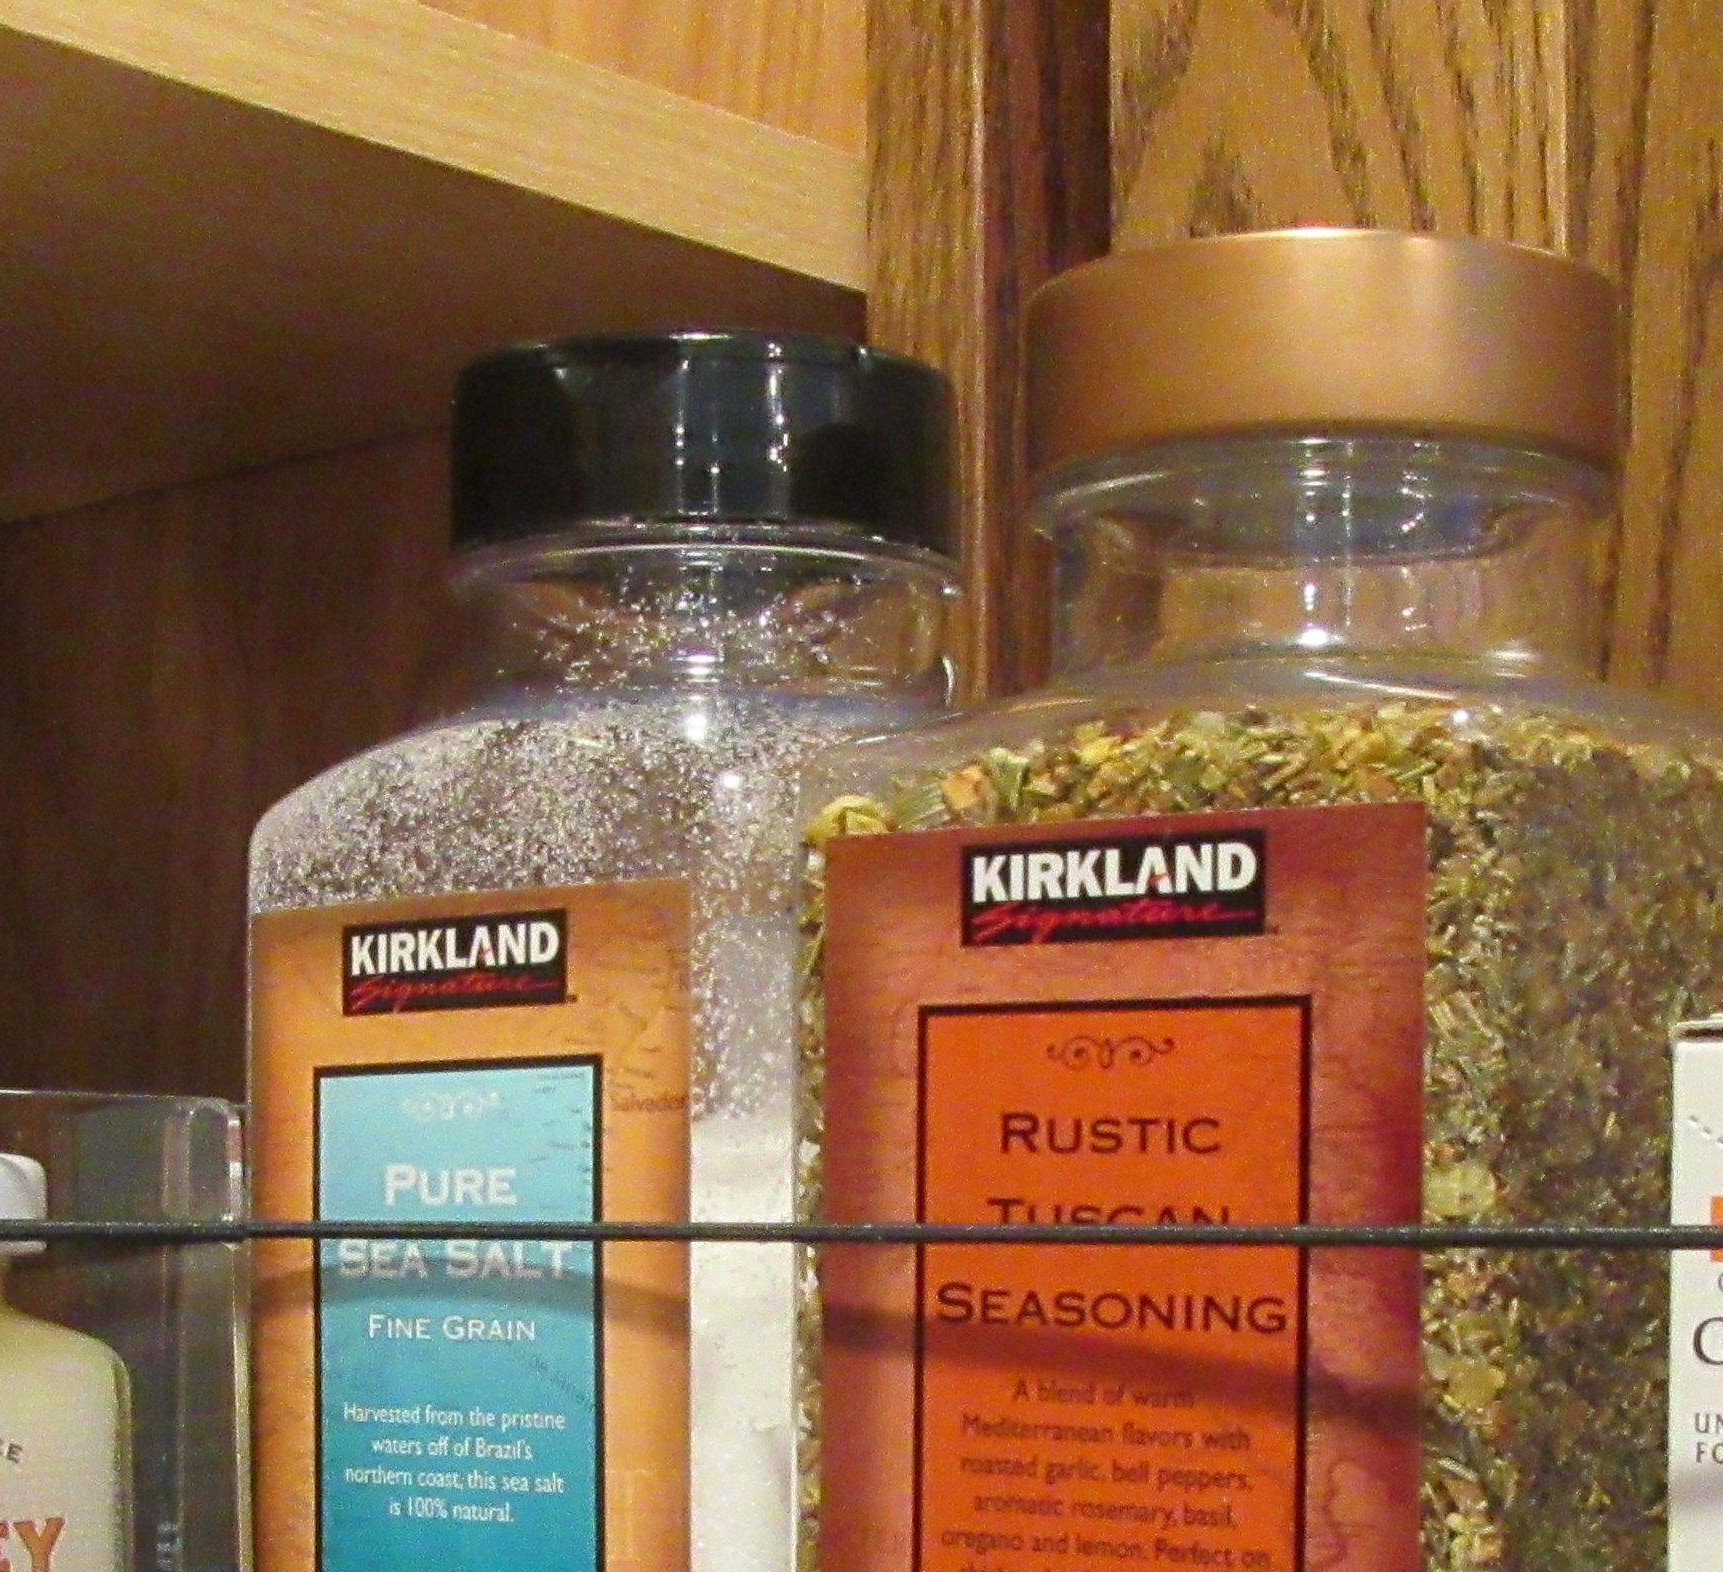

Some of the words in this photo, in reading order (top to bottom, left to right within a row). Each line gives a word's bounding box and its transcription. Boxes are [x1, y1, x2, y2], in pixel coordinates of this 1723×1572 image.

[970, 842, 1258, 903] KIRKLAND
[970, 897, 1258, 943] Signature
[349, 921, 560, 977] KIRKLAND
[349, 968, 562, 1012] Signature
[999, 1112, 1220, 1155] RUSTIC
[383, 1162, 518, 1206] PURE
[336, 1240, 428, 1279] SEA
[444, 1240, 574, 1280] SALT
[935, 1281, 1287, 1335] SEASONING
[367, 1314, 431, 1340] FINE
[442, 1315, 537, 1342] GRAIN
[1012, 1379, 1028, 1402] A
[1036, 1379, 1096, 1404] blend
[1102, 1382, 1125, 1406] of
[344, 1402, 421, 1425] Harvested
[425, 1404, 464, 1427] from
[469, 1407, 496, 1427] the
[501, 1411, 566, 1433] pristine
[962, 1412, 1113, 1443] Mediterranean
[1122, 1421, 1193, 1448] flavors
[1201, 1427, 1252, 1450] with
[371, 1439, 422, 1456] waters
[427, 1436, 450, 1457] off
[453, 1437, 472, 1458] of
[475, 1437, 534, 1461] Brazil's
[344, 1464, 413, 1486] northern
[417, 1470, 465, 1490] coast,
[466, 1469, 497, 1491] this
[501, 1475, 530, 1492] sea
[533, 1472, 565, 1494] salt
[961, 1456, 1038, 1477] roasted
[1112, 1459, 1150, 1483] bell
[1156, 1467, 1253, 1492] peppers,
[389, 1498, 401, 1517] is
[407, 1497, 448, 1519] 100%
[452, 1502, 515, 1523] natural.
[973, 1494, 1063, 1516] aromatic
[1072, 1501, 1177, 1530] rosemary,
[1184, 1504, 1237, 1529] basil,
[941, 1529, 1025, 1555] oregano
[1031, 1535, 1071, 1555] and
[1154, 1538, 1232, 1568] Perfect
[1240, 1550, 1272, 1569] on
